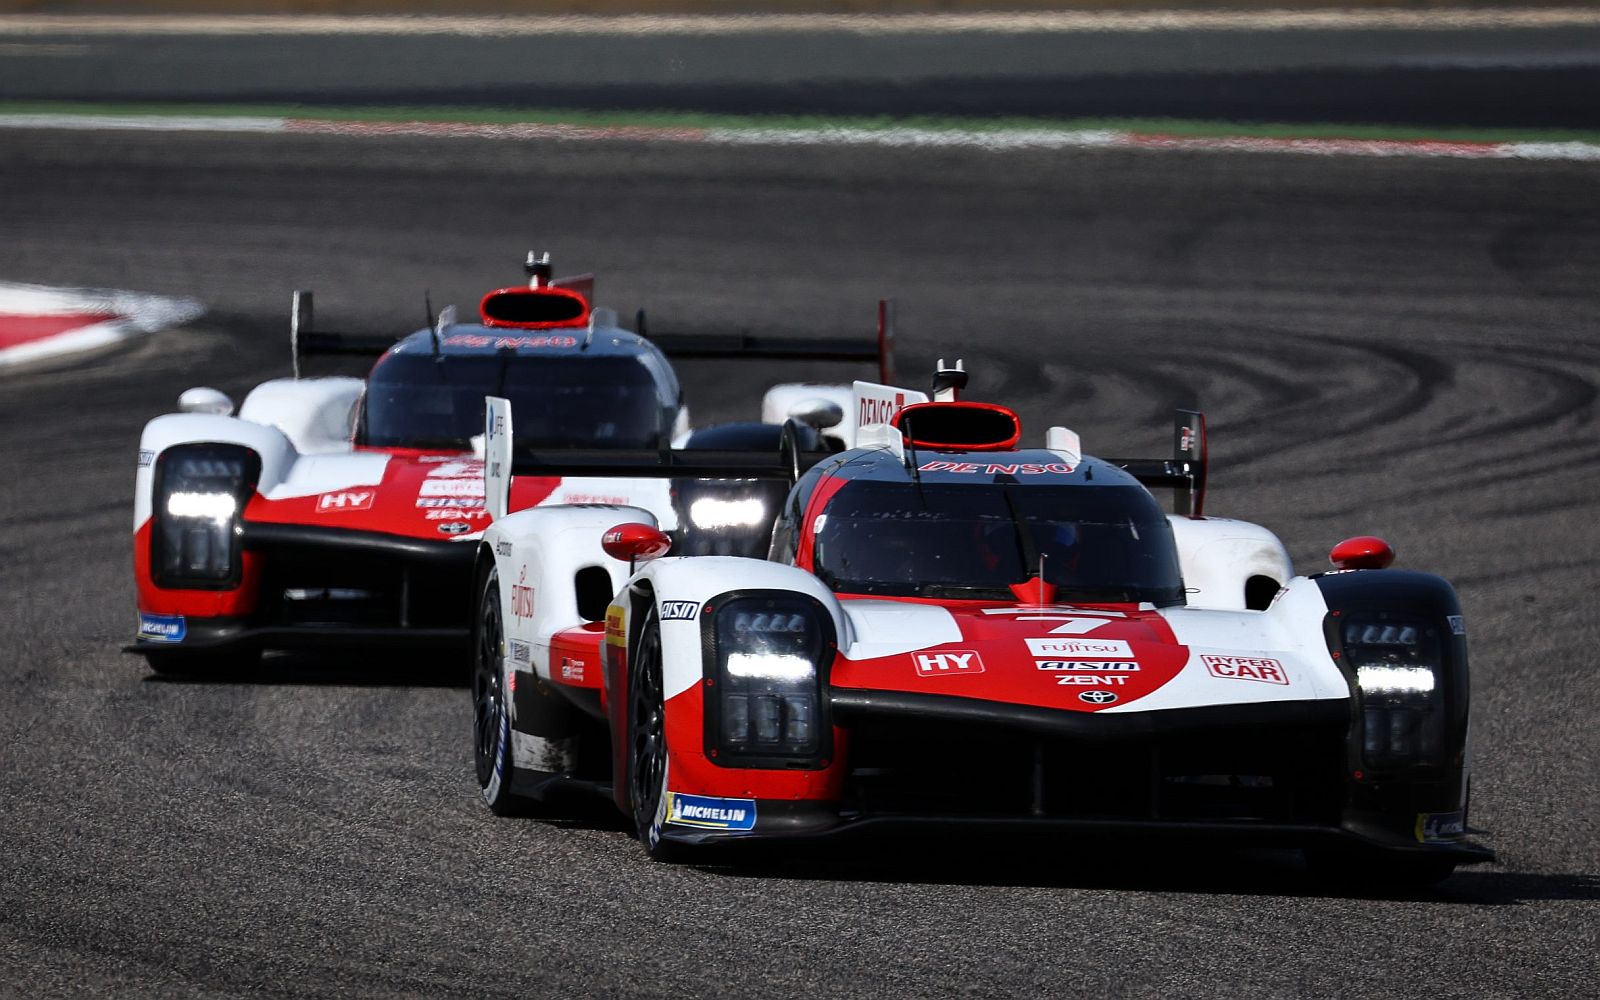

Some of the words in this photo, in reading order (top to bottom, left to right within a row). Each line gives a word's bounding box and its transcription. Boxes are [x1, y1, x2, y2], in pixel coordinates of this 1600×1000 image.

[918, 461, 1075, 474] DENSO
[320, 492, 370, 508] HY
[425, 509, 488, 519] ZENT
[661, 602, 699, 619] AISIN
[1015, 616, 1112, 634] 7
[1041, 642, 1118, 653] FUJITSU
[917, 653, 974, 671] HY
[1040, 661, 1136, 670] AISIN
[1207, 656, 1275, 668] HYPER
[1212, 663, 1281, 681] CAR
[1055, 675, 1130, 685] ZENT
[682, 805, 746, 822] MICHELIN
